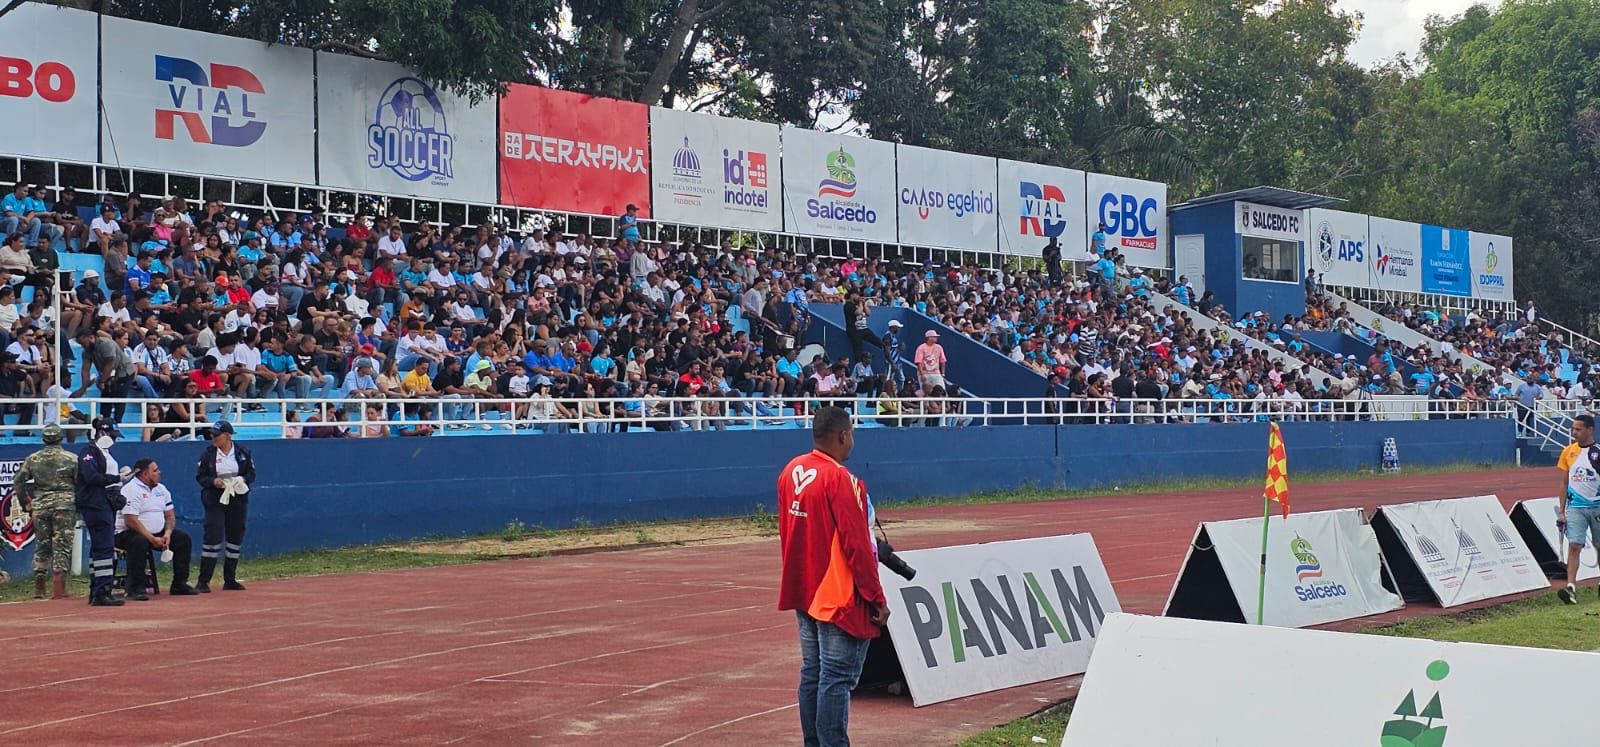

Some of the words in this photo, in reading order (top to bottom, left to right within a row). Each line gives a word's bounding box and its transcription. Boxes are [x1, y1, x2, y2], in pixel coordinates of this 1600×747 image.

[168, 84, 256, 118] VIAL
[402, 106, 423, 130] ALL
[368, 123, 454, 179] SOCCER
[724, 185, 768, 208] indotel
[947, 190, 993, 218] egehid
[807, 198, 876, 223] Salcedo
[1025, 200, 1062, 218] VIAL
[1099, 192, 1157, 237] GBC
[1252, 210, 1288, 233] SALCEDO
[1289, 215, 1299, 233] FC
[1125, 239, 1155, 249] FARMACIAS
[1338, 240, 1364, 262] APS
[1480, 274, 1505, 286] IDOPPRIL
[1295, 582, 1347, 601] Salcedo
[900, 565, 1105, 668] PANAM
